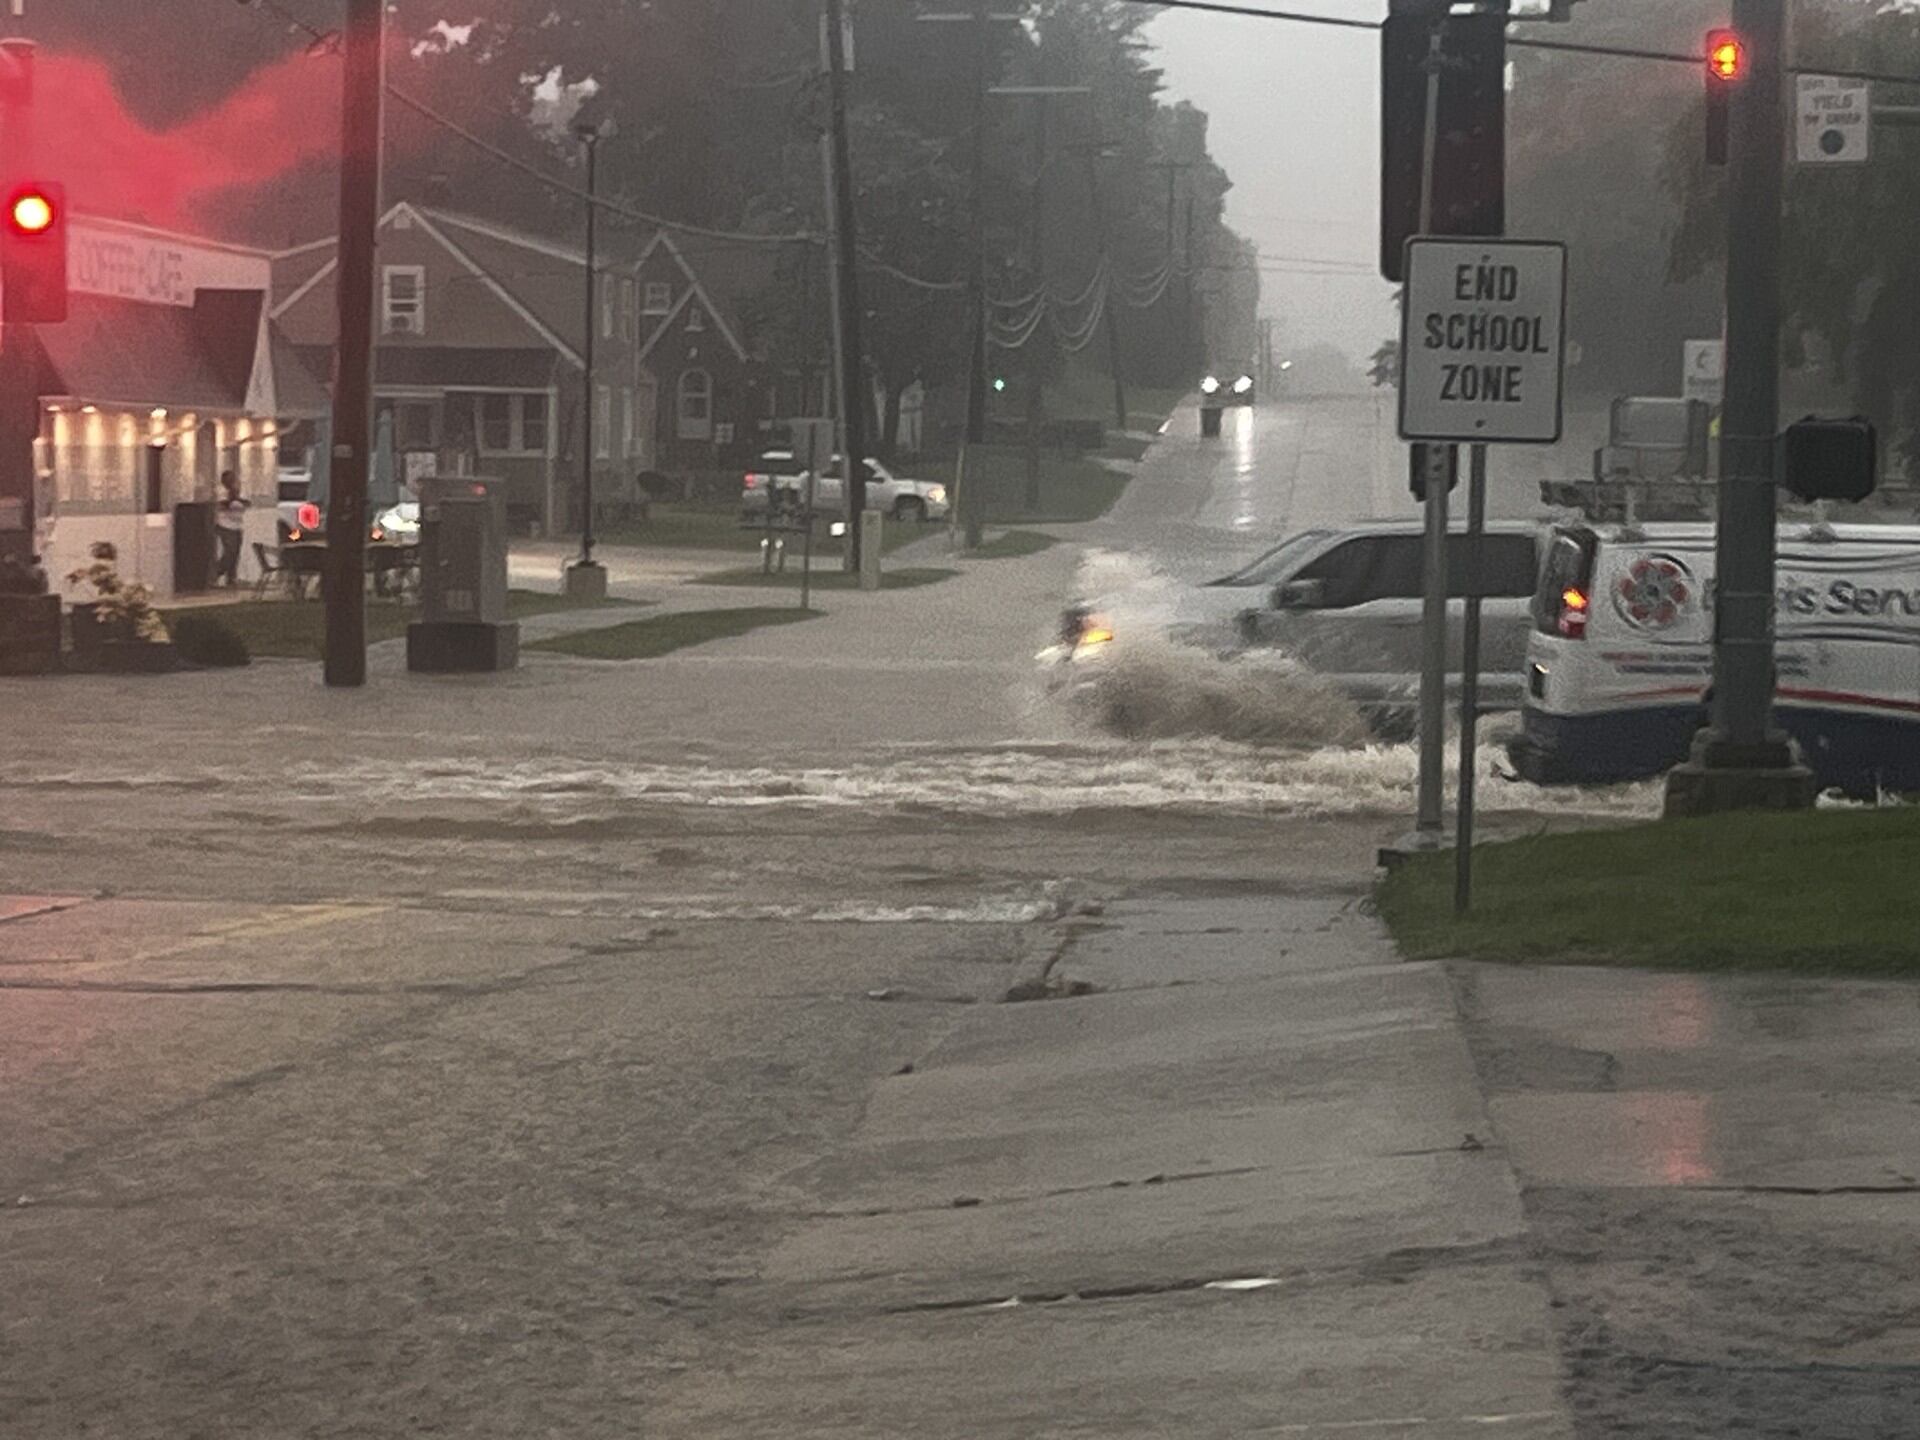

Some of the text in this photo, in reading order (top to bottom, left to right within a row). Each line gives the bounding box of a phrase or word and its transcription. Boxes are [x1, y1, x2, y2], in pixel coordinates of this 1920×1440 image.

[1456, 264, 1518, 301] END
[1424, 312, 1549, 354] SCHOOL
[1440, 363, 1522, 402] ZONE
